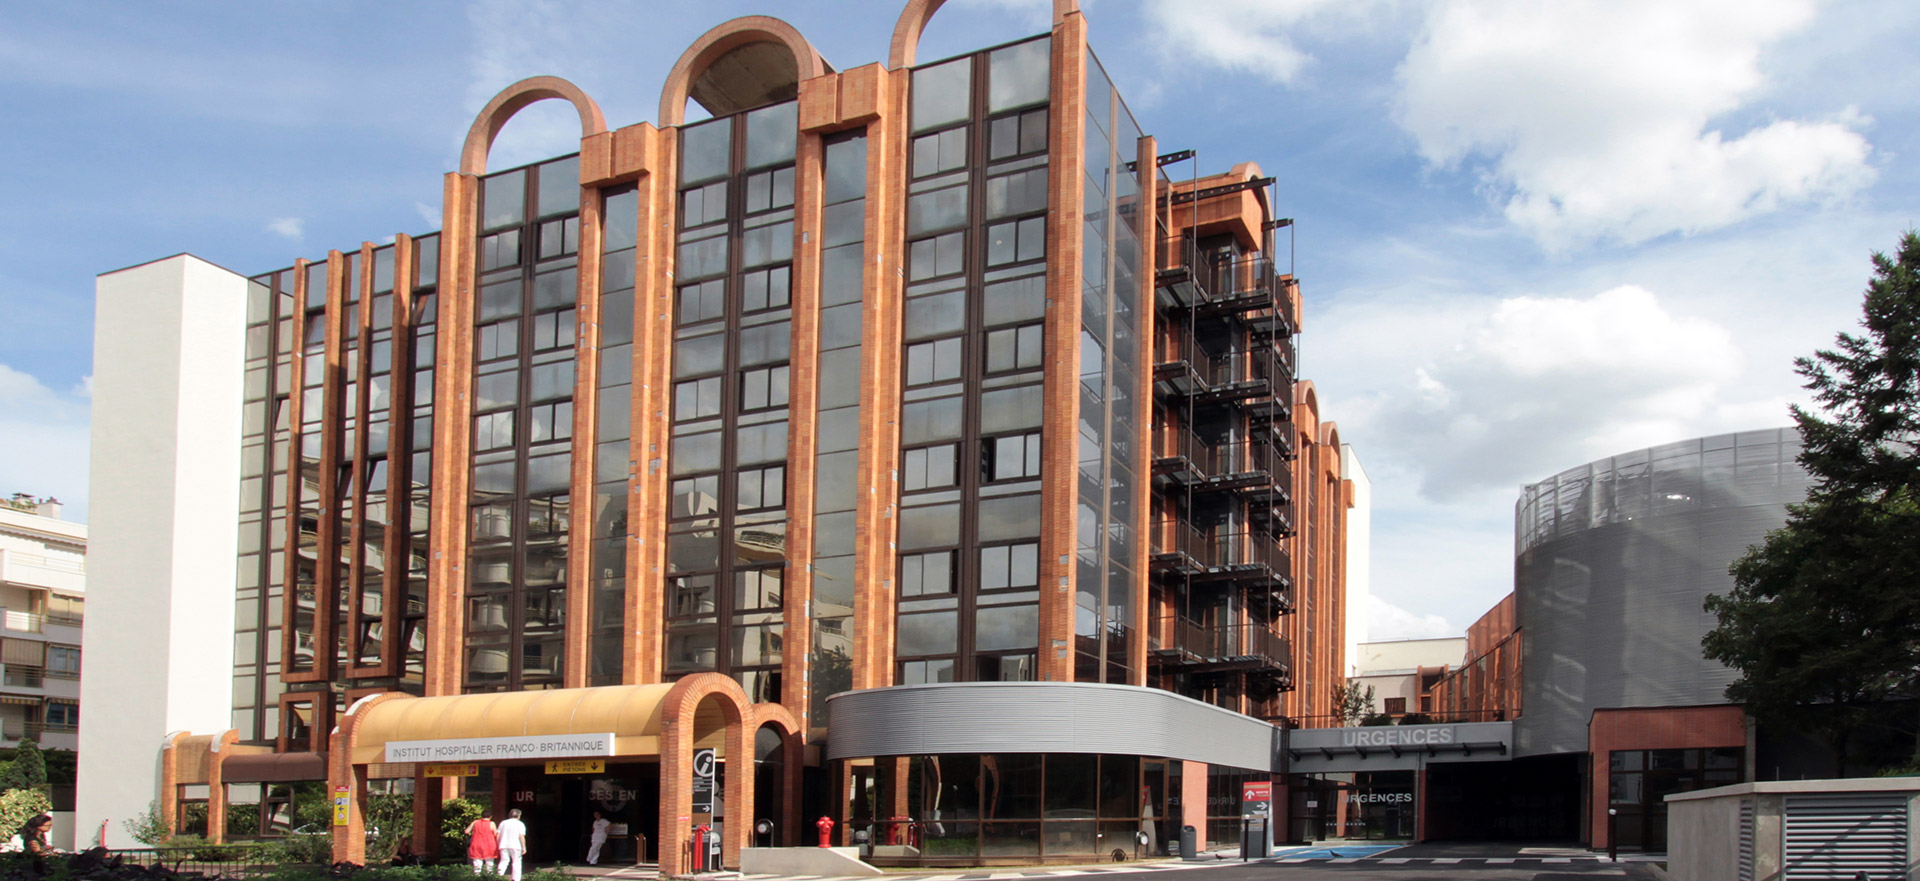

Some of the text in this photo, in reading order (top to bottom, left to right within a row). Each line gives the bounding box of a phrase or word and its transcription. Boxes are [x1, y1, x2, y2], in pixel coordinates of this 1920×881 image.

[1344, 728, 1452, 746] URGENCES
[393, 747, 432, 758] INSTITUT
[435, 744, 493, 756] HOSPITALIER
[1342, 792, 1413, 804] URGENCES
